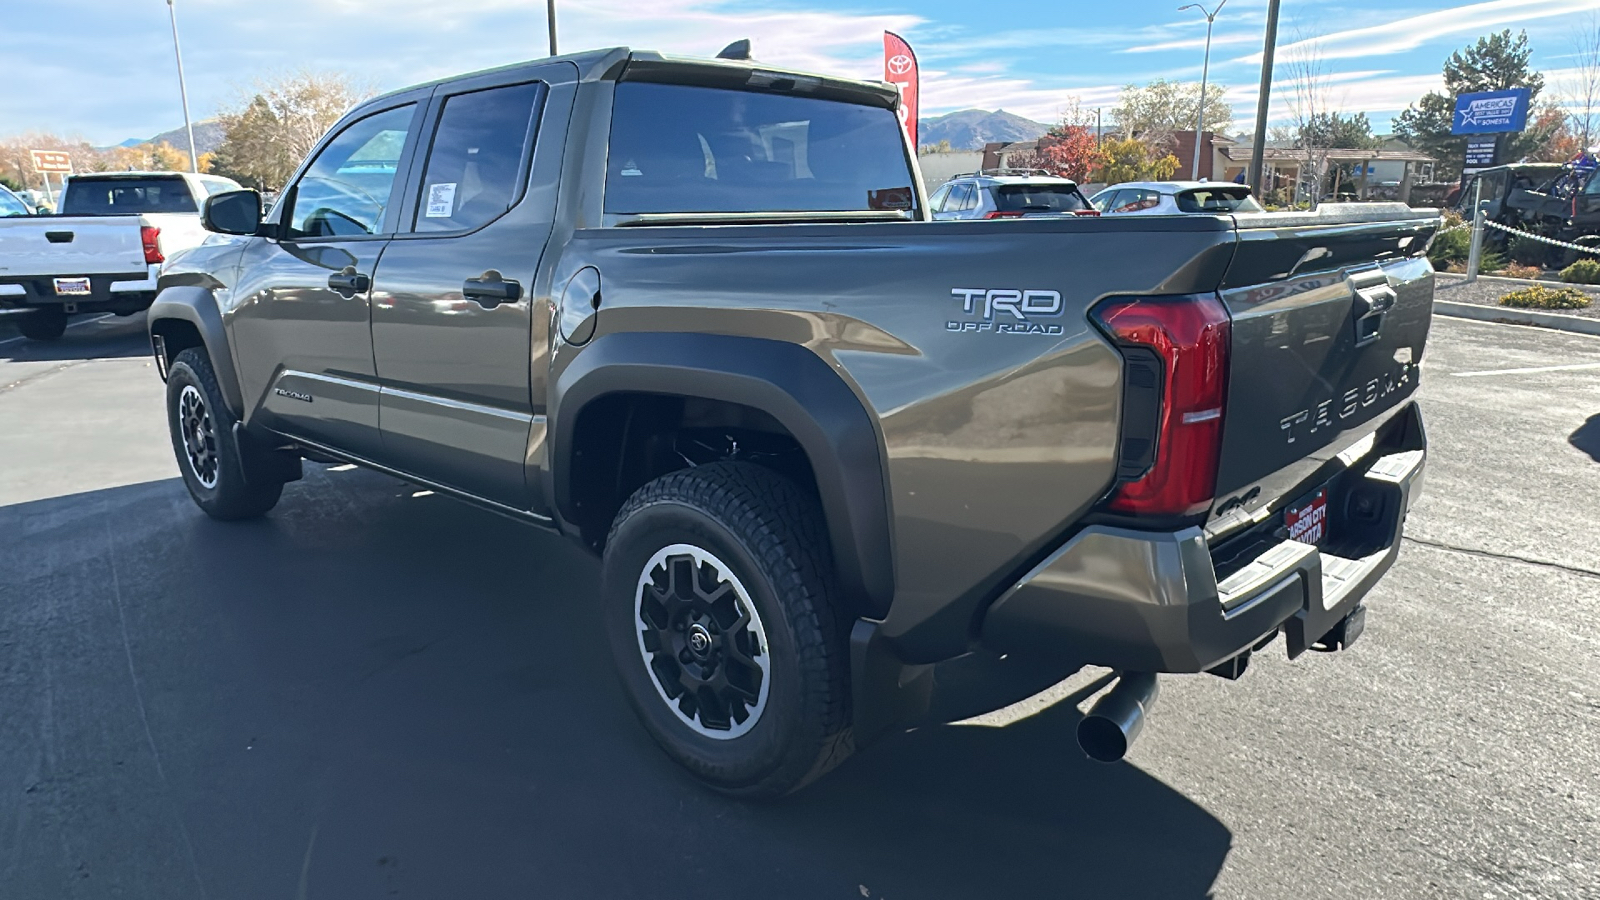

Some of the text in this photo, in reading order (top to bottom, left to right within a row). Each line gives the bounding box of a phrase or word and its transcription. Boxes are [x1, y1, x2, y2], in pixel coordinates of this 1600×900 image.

[1475, 99, 1513, 109] AMERICAS
[951, 287, 1063, 320] TRD
[946, 321, 1064, 336] OFF ROAD
[275, 388, 313, 403] TACOMA
[1288, 512, 1313, 540] ARSON
[1296, 522, 1322, 544] YOTA
